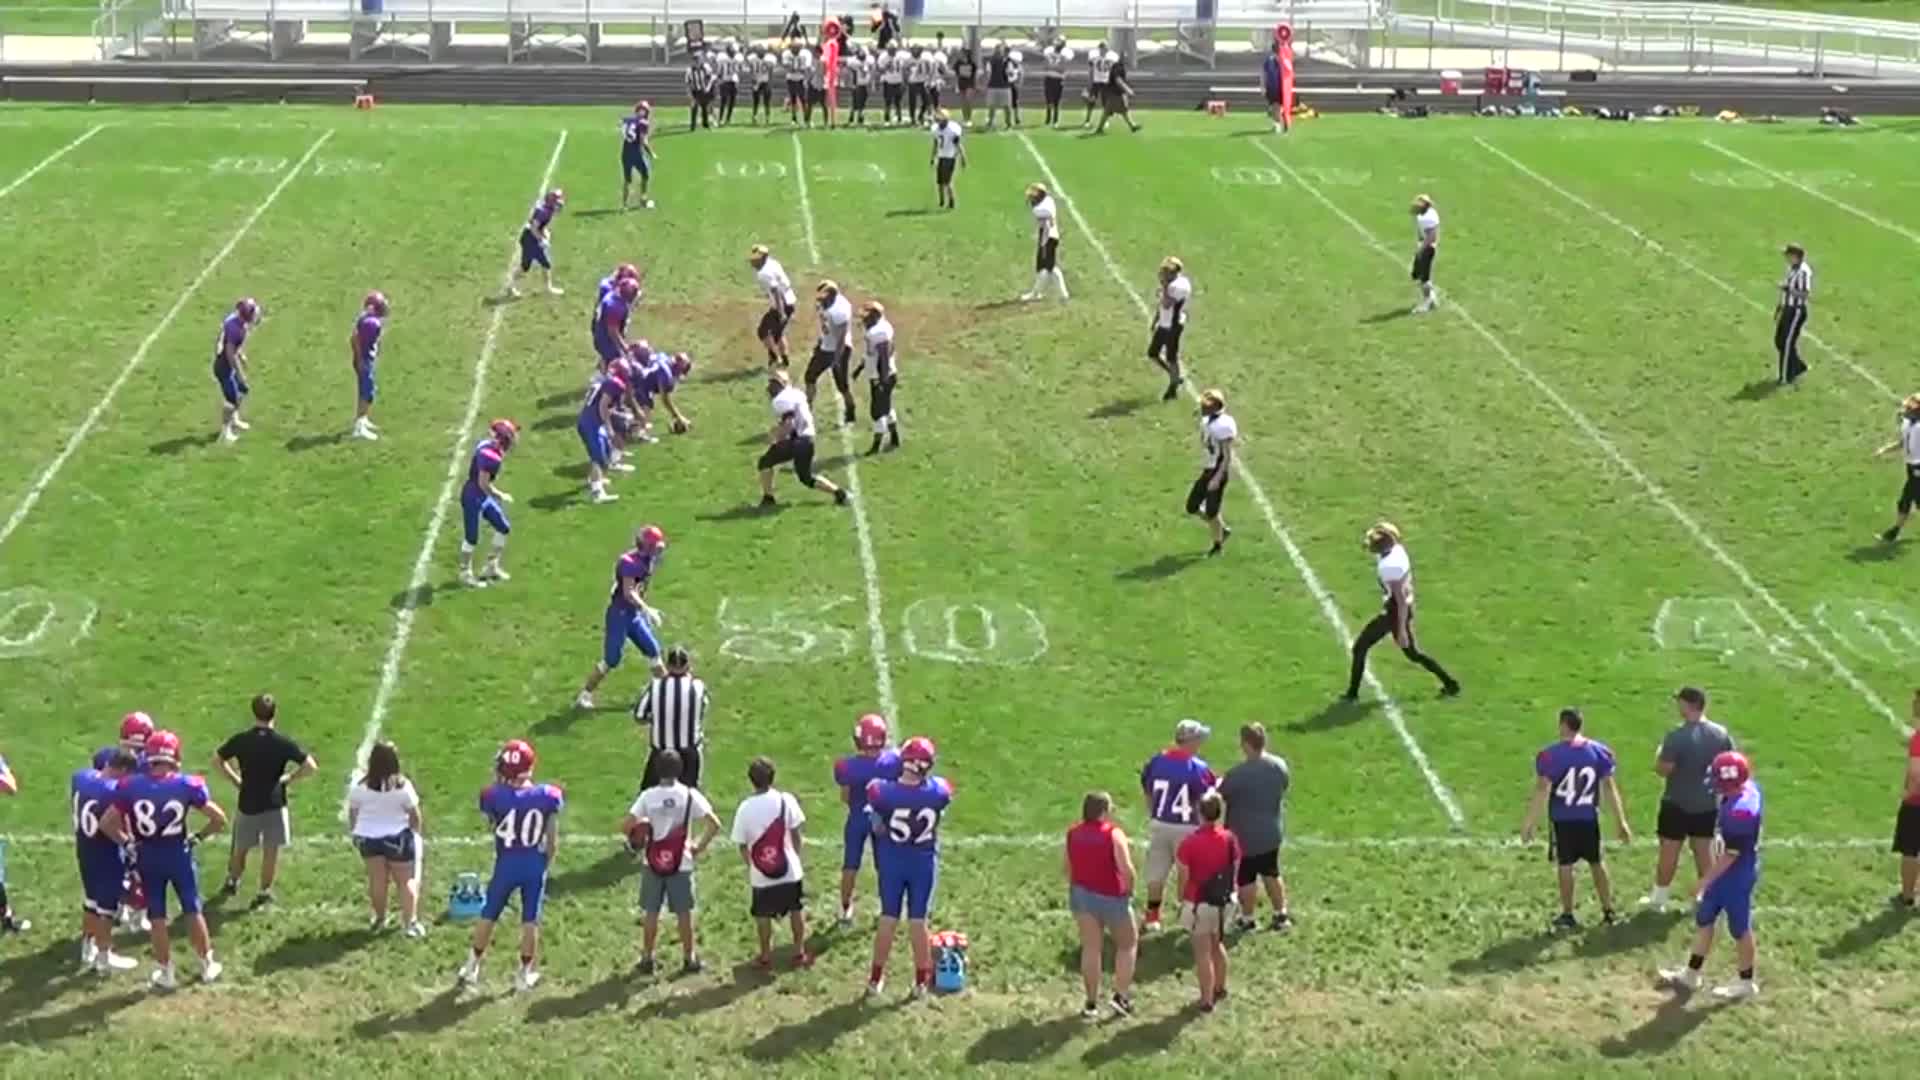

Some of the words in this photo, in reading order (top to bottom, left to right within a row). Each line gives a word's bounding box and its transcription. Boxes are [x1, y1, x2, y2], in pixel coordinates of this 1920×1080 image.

[502, 751, 521, 764] 40
[1153, 779, 1193, 822] 74
[1555, 765, 1597, 807] 42
[133, 798, 185, 838] 82
[495, 807, 544, 848] 40
[889, 807, 937, 844] 52
